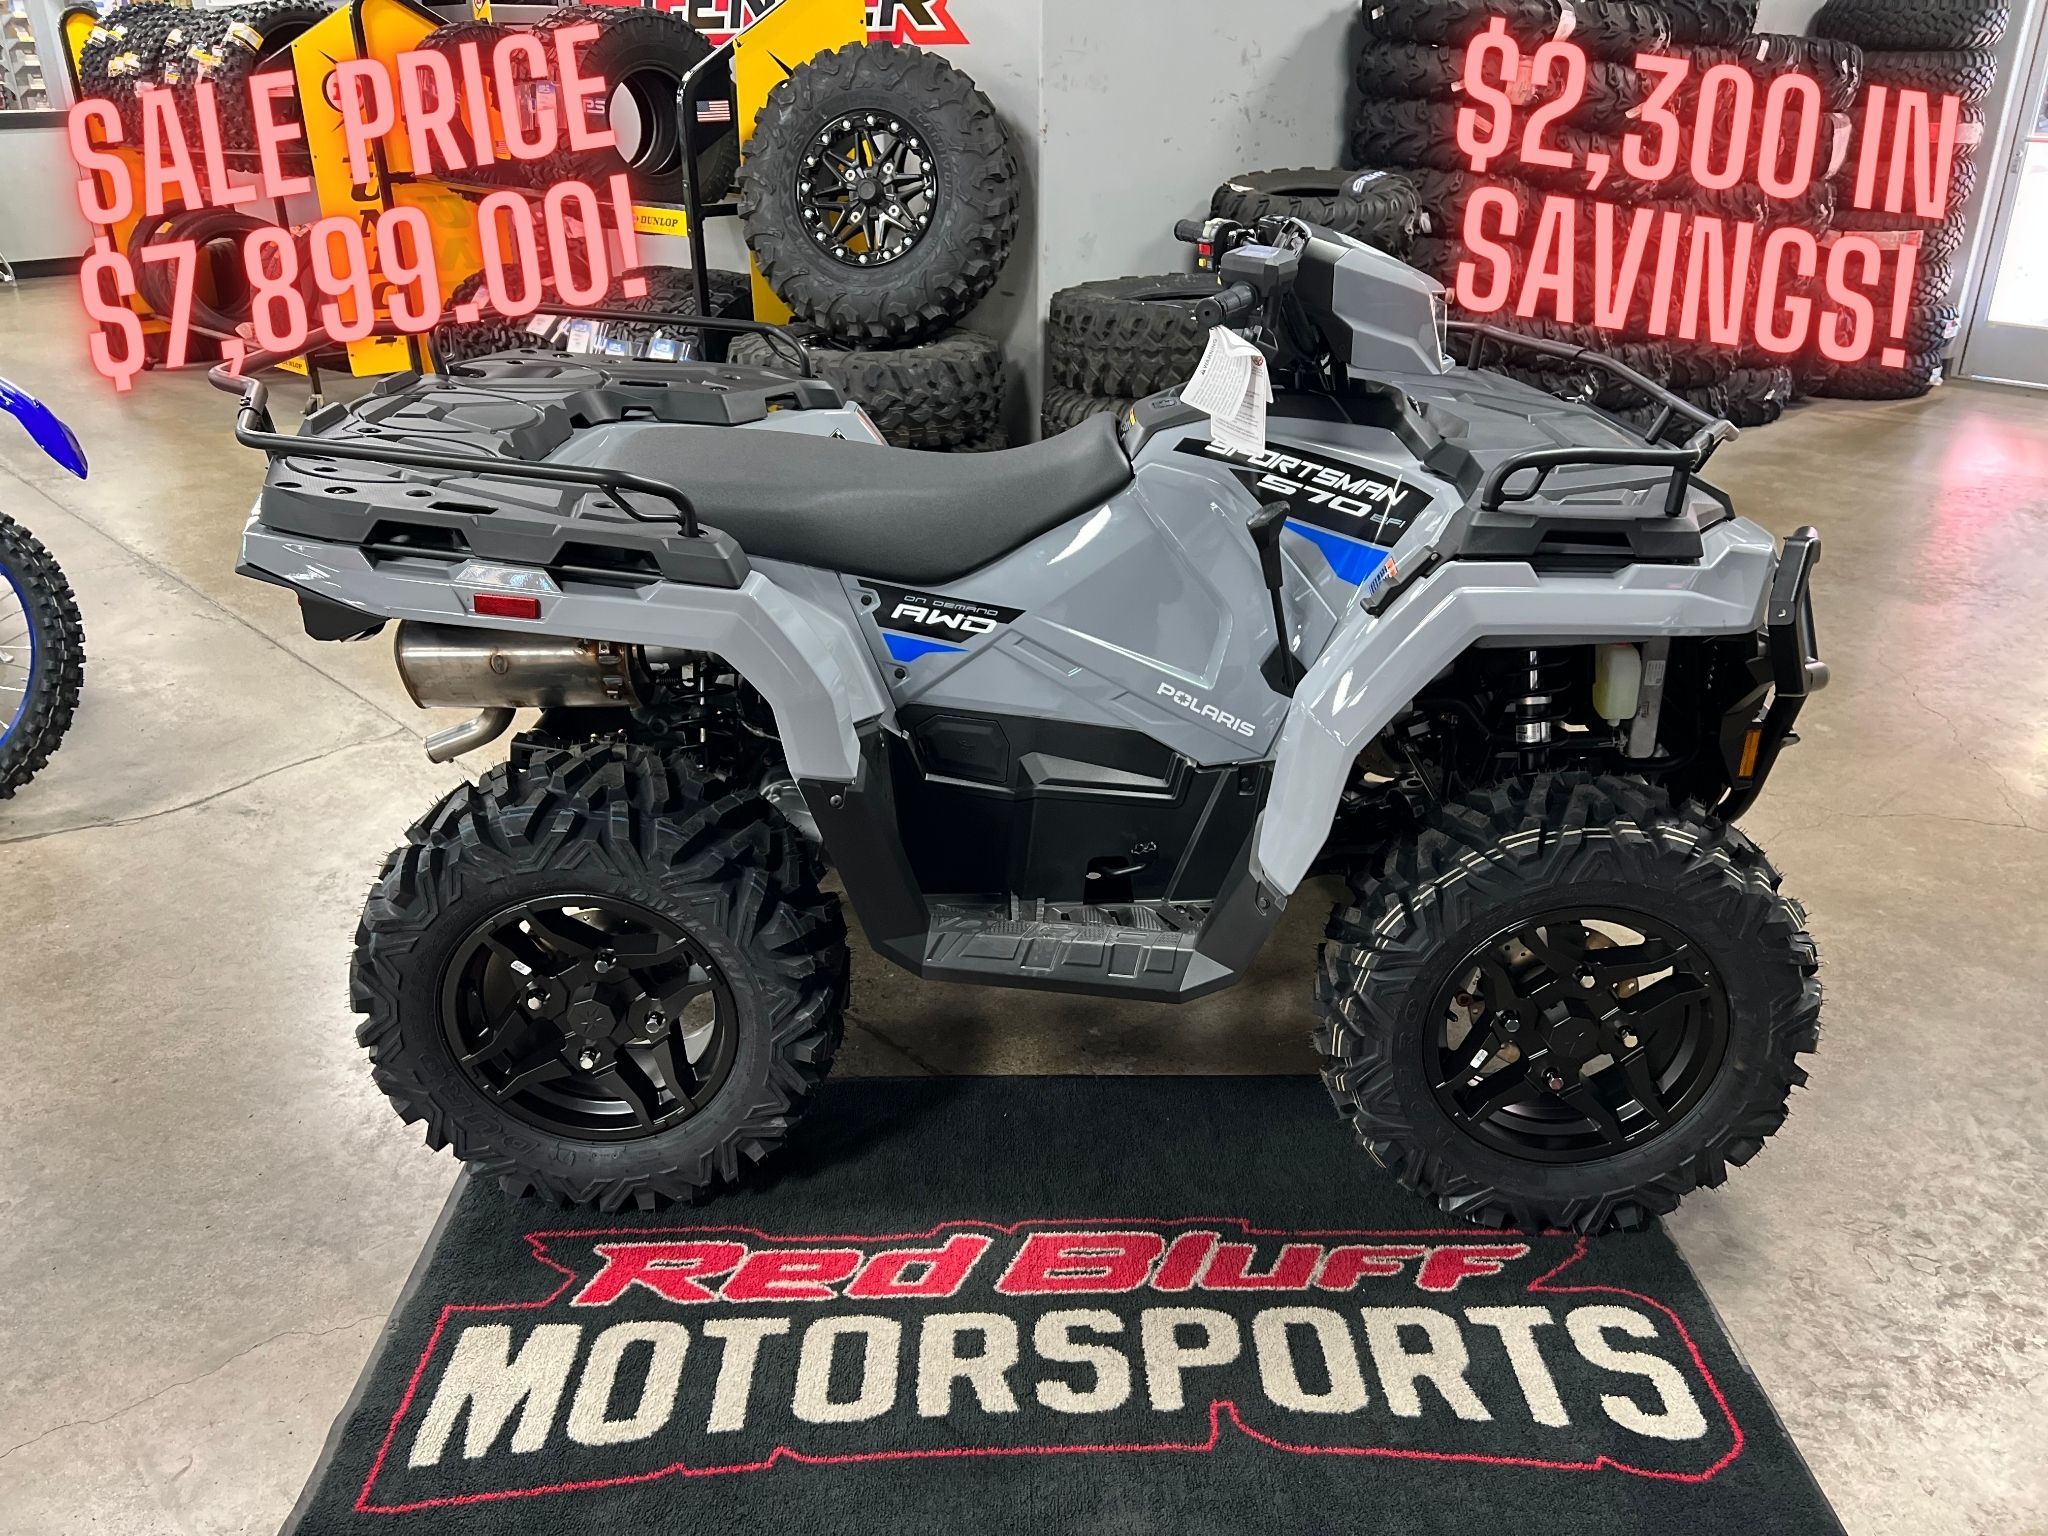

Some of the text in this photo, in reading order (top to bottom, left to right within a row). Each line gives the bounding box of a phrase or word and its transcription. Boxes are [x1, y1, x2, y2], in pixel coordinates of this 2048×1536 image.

[640, 215, 679, 227] DUNLOP
[1203, 338, 1218, 370] WARNING
[1257, 474, 1372, 517] 570
[891, 603, 998, 634] AWD
[904, 595, 999, 616] ON DEMAND
[1157, 682, 1256, 737] POLARIS
[570, 1233, 993, 1307] Red
[406, 1303, 1711, 1470] MOTORSPORTS
